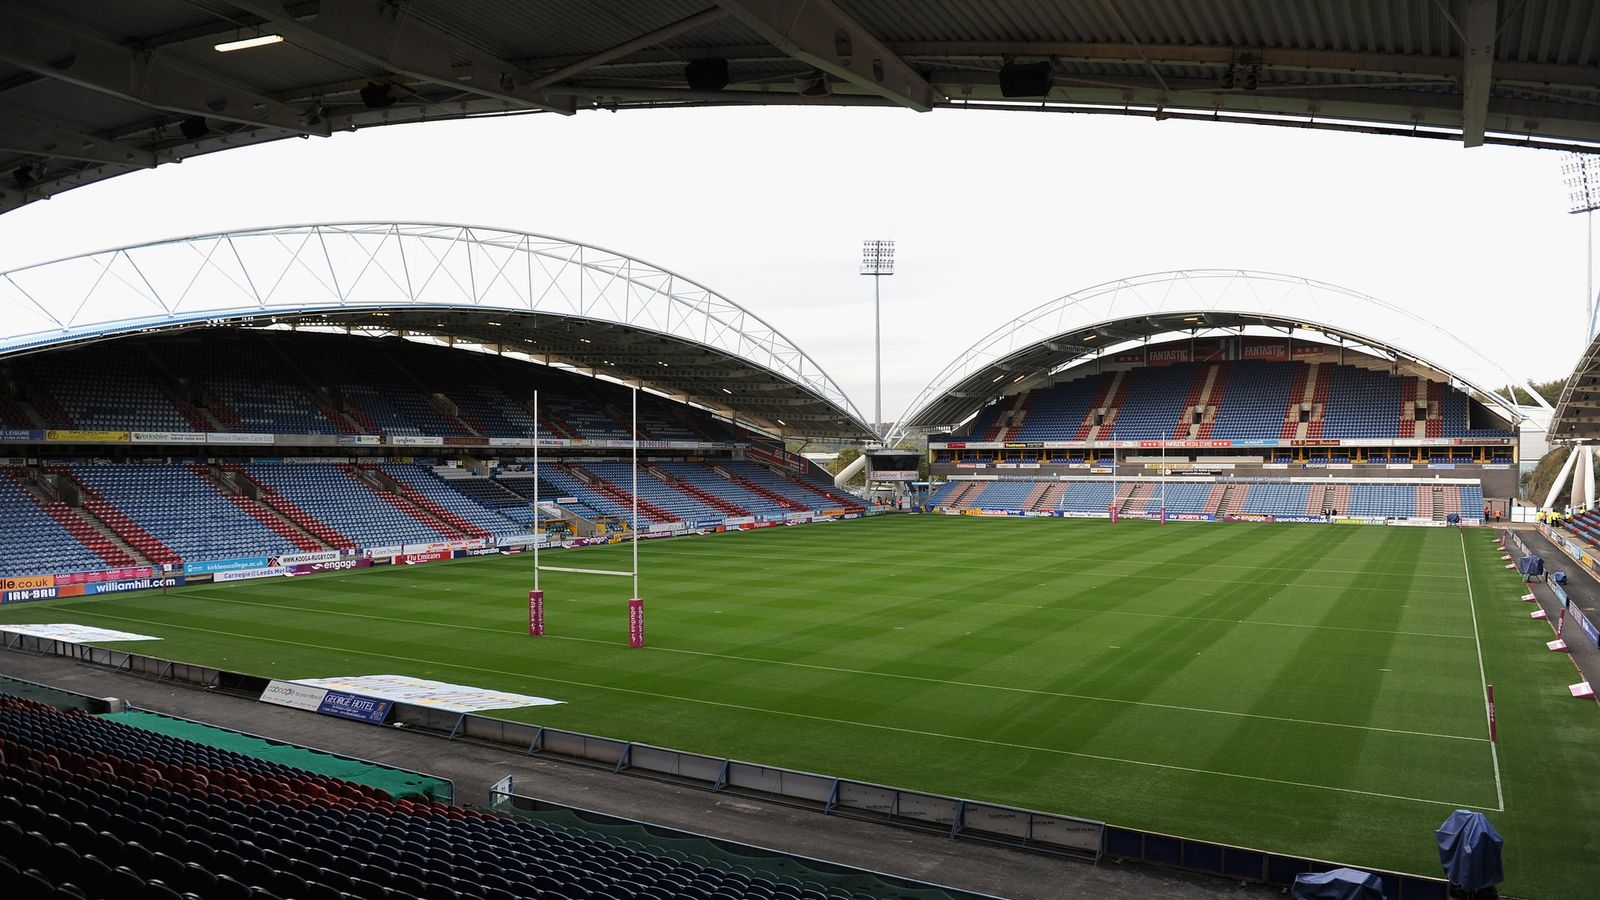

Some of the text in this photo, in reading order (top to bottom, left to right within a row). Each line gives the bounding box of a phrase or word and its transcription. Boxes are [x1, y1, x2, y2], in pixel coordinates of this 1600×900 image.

[1150, 350, 1188, 361] FANTASTIC
[1244, 345, 1285, 357] FANTASTIC
[324, 559, 357, 570] engage
[96, 577, 176, 593] williamhill.com
[8, 588, 56, 601] IRN-BRU
[325, 694, 351, 706] GEORGE
[351, 699, 375, 711] HOTEL
